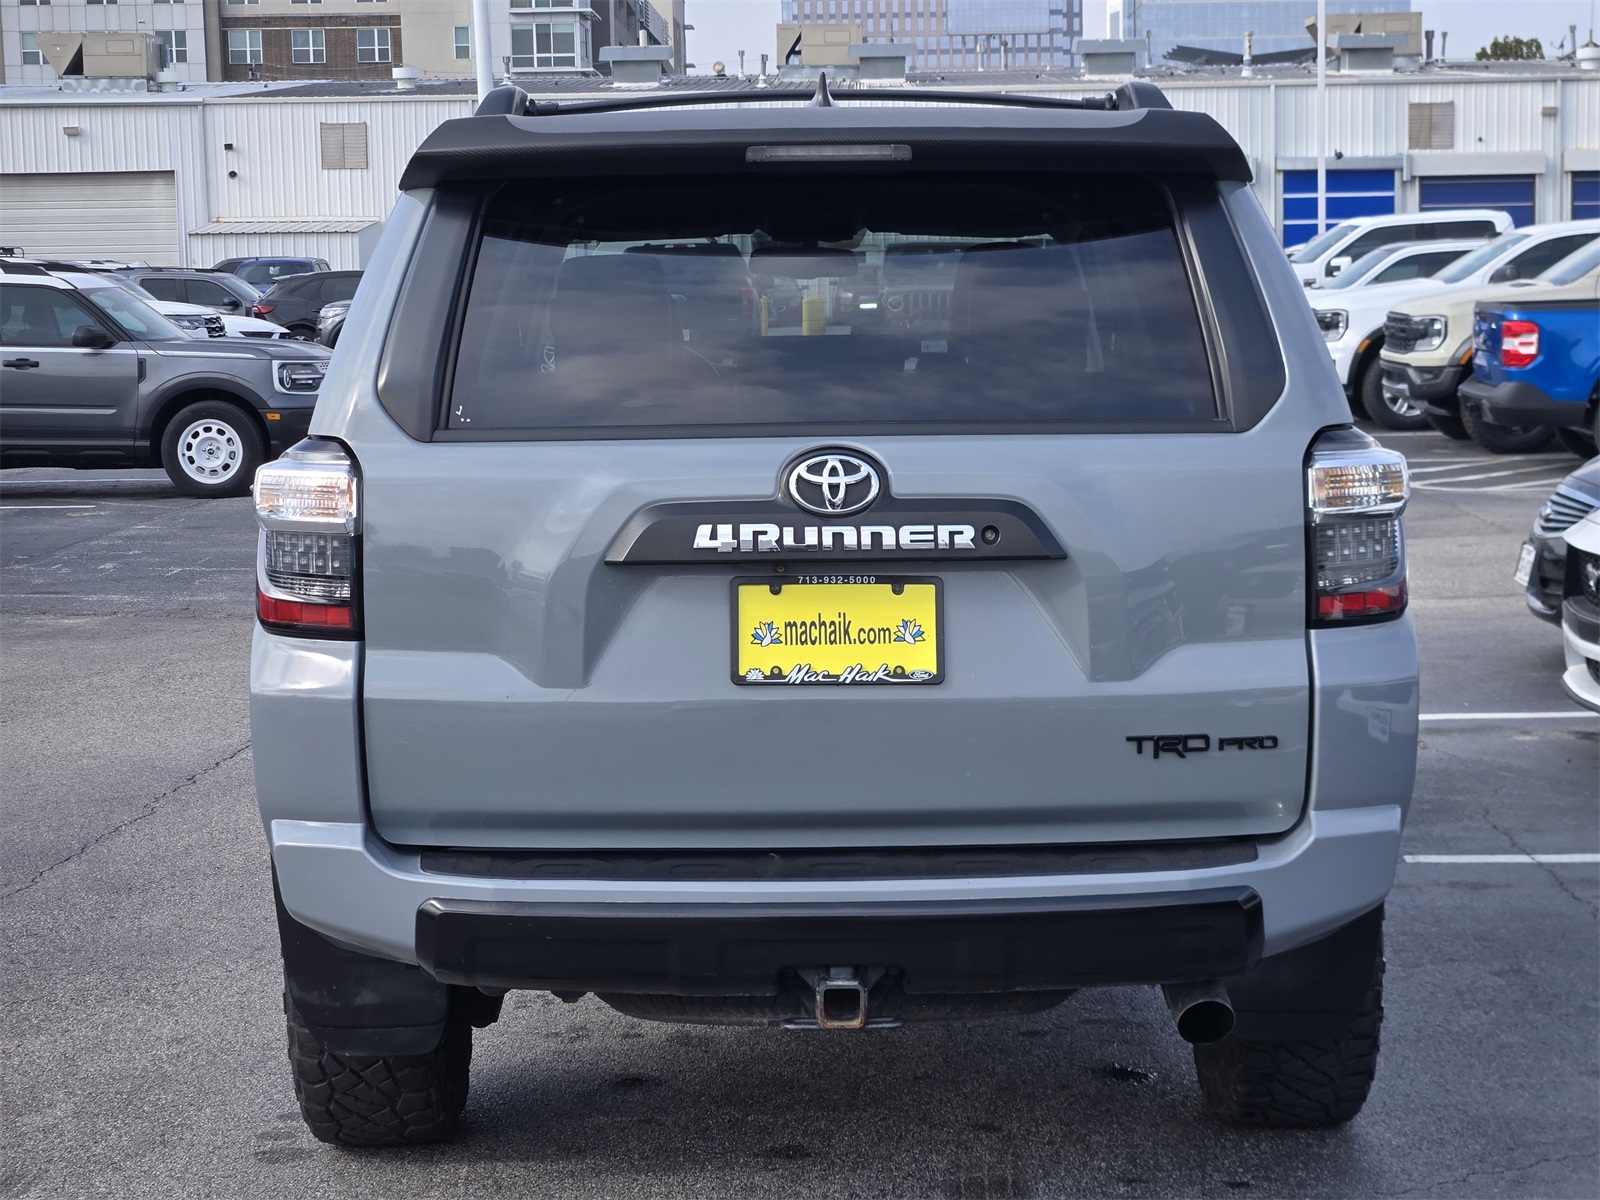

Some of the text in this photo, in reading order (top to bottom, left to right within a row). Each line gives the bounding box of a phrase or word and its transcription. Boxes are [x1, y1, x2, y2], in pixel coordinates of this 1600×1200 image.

[693, 523, 976, 553] 4RUNNER
[797, 575, 877, 585] 713-932-5000
[784, 612, 892, 646] machaik.com
[788, 663, 892, 685] Mac Haik
[910, 670, 932, 680] Ford
[1125, 733, 1279, 760] TRD PRO
